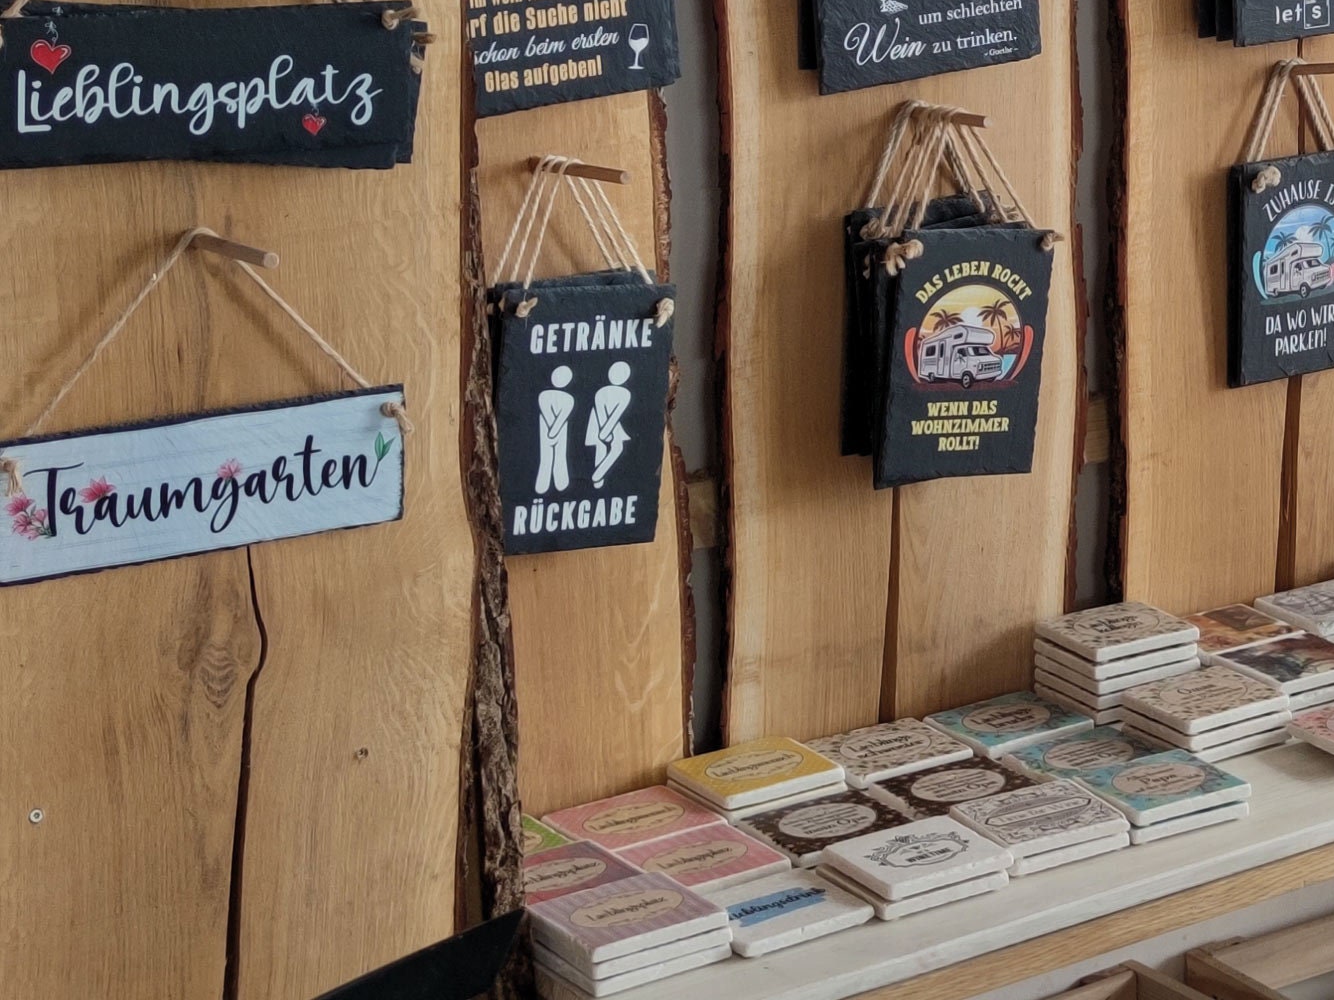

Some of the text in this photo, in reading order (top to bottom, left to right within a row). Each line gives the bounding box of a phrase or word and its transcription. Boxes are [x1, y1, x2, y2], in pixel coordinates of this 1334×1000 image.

[493, 10, 521, 35] die
[526, 3, 578, 30] Suche
[919, 11, 941, 25] um
[524, 26, 620, 57] beim ersten
[844, 17, 1017, 66] Wein zu trinken.
[484, 55, 603, 93] Glas aufgeben!
[17, 54, 383, 135] Lieblingsplatz
[1262, 179, 1323, 223] ZUHAUSE
[916, 261, 1032, 304] DAS LEBEN ROCKT
[530, 315, 653, 354] GETRÄNKE
[1265, 316, 1282, 336] DA
[1286, 309, 1306, 332] WO
[1275, 328, 1327, 357] PARKEN!
[927, 400, 997, 416] WENN DAS
[911, 418, 1009, 435] WOHNZIMMER
[937, 436, 979, 451] ROLLT!
[23, 435, 380, 537] Traumgarten
[513, 495, 638, 535] RÜCKGABE
